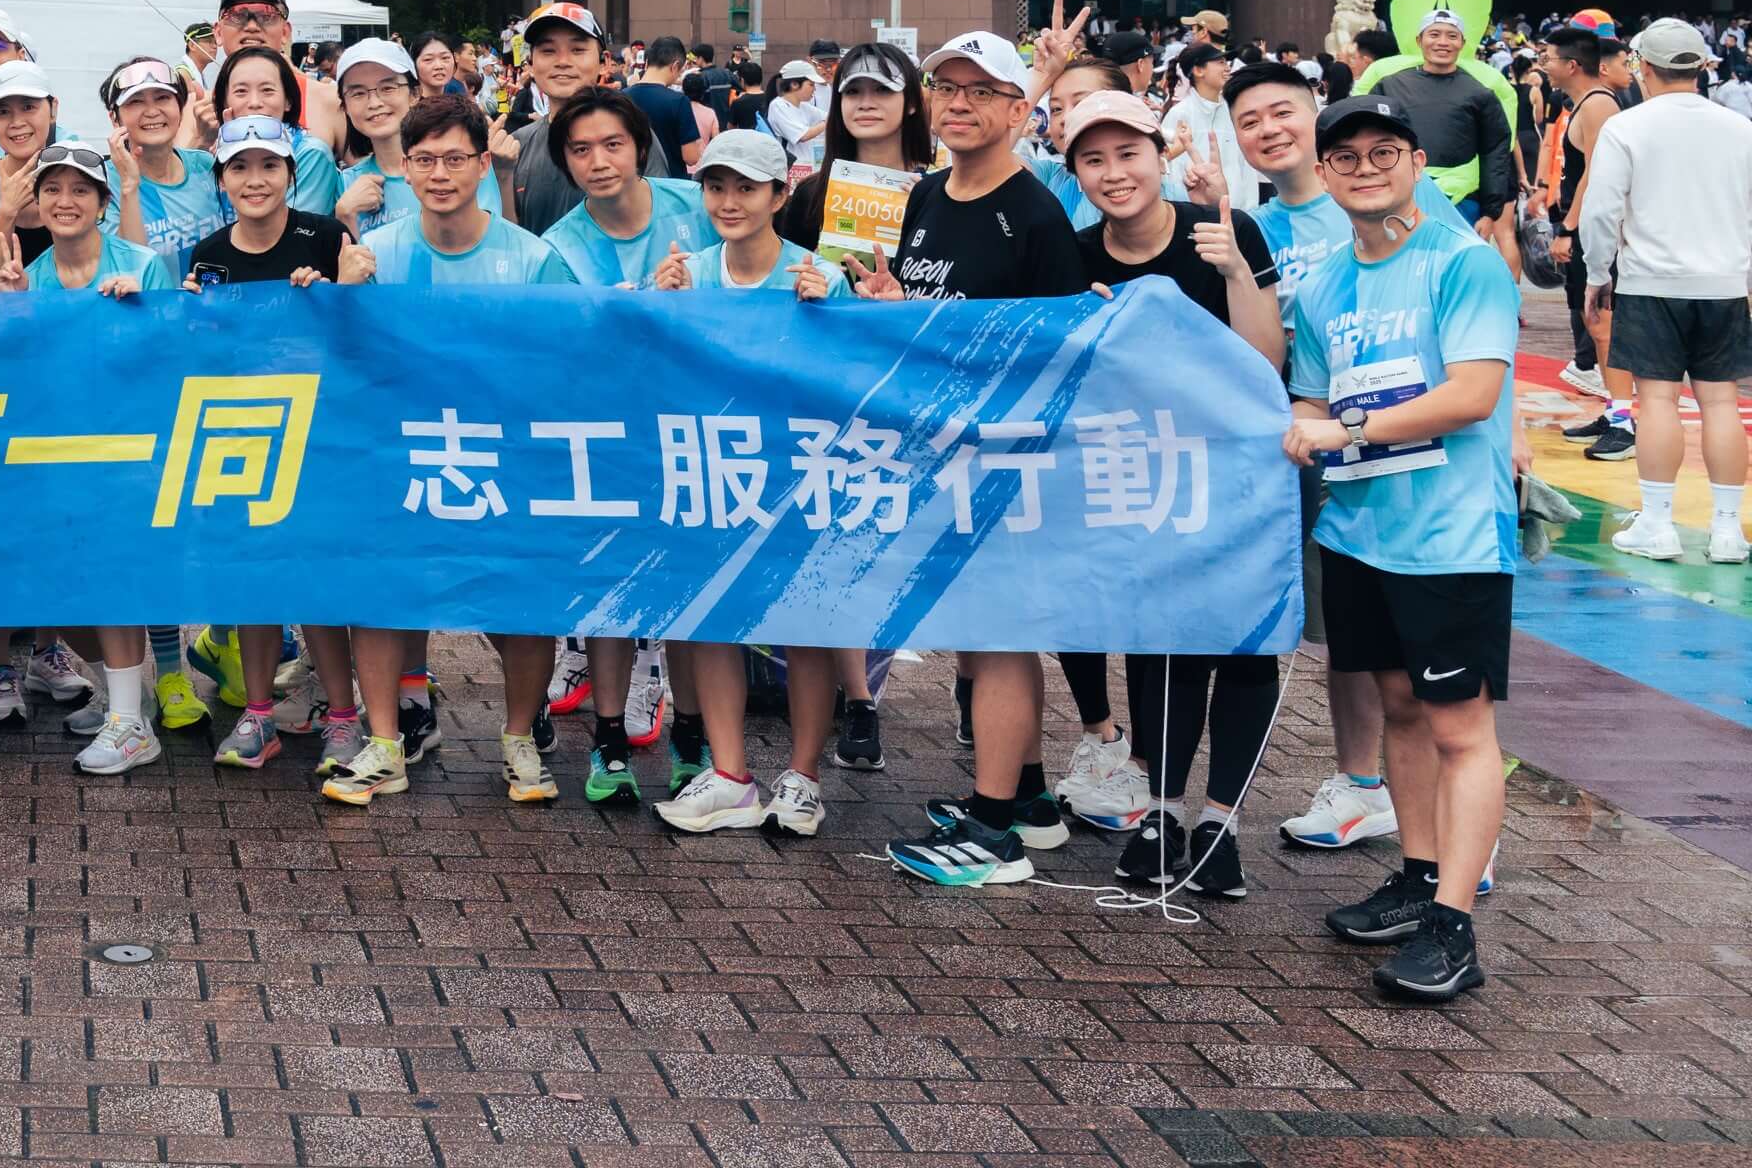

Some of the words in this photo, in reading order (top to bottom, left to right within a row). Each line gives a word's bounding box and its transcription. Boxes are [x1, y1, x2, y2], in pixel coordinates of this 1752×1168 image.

[829, 194, 906, 224] 240050
[899, 256, 955, 285] FUBON
[1356, 394, 1382, 406] MALE
[401, 406, 1212, 535] 志工服務行動
